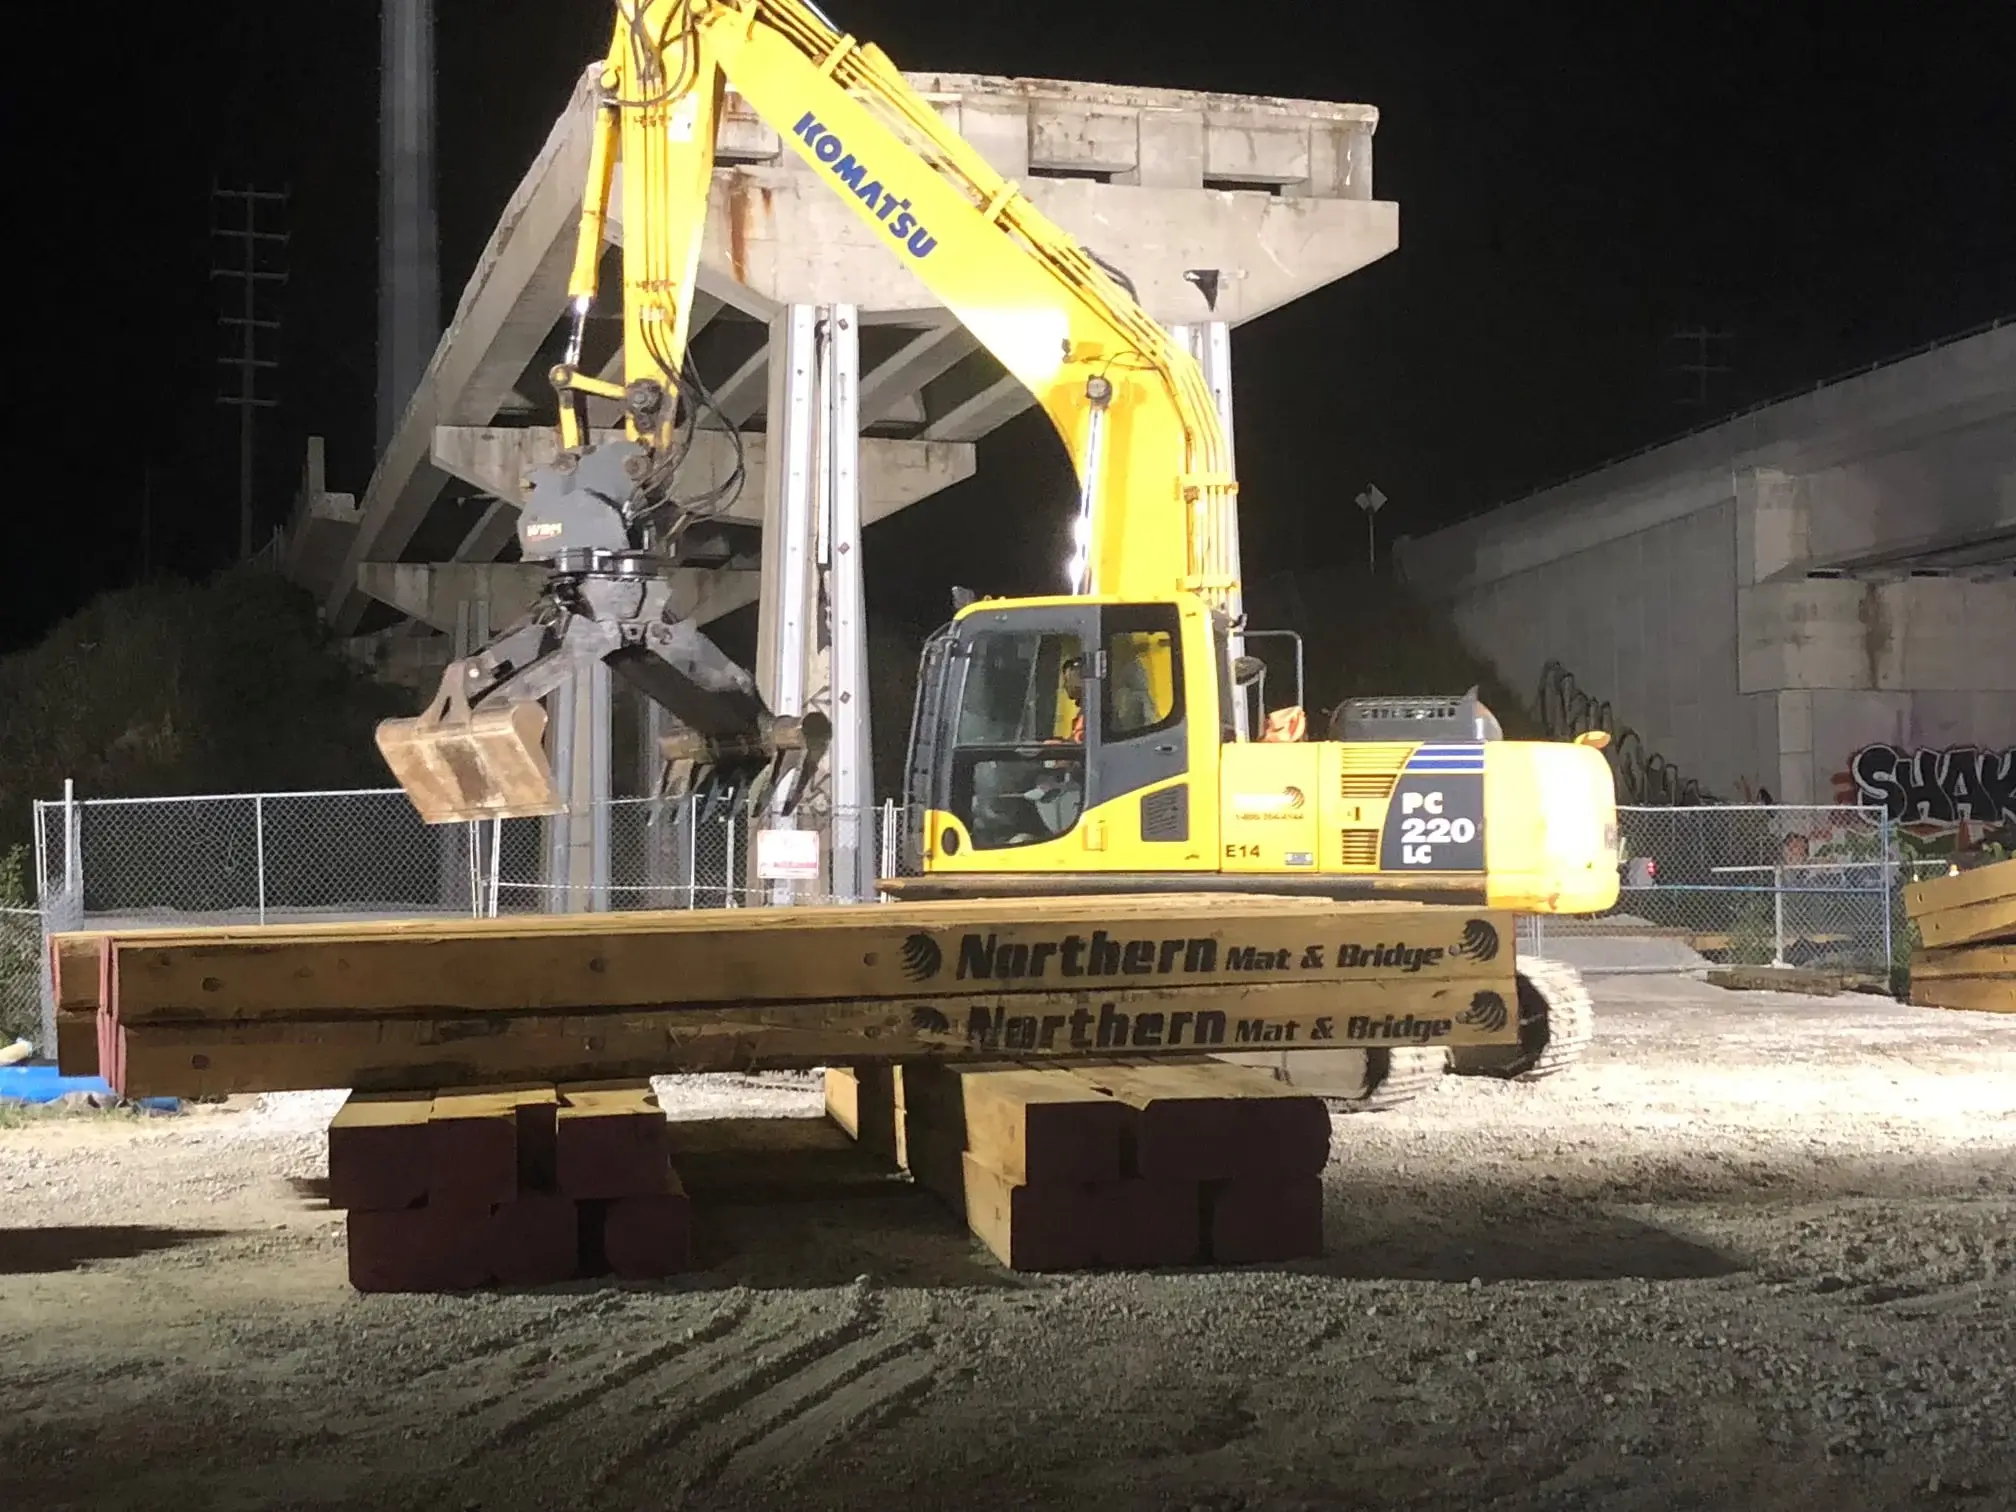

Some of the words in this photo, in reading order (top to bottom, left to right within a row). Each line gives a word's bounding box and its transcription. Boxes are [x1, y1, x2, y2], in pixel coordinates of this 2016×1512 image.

[792, 111, 938, 258] KOMATSU
[1402, 791, 1443, 815] PC
[1401, 817, 1475, 844] 220
[1226, 844, 1260, 858] E14
[1402, 844, 1432, 864] LC
[956, 931, 1218, 981] Northern
[1225, 946, 1291, 971] Mat
[1300, 945, 1324, 970] &
[1336, 942, 1444, 973] Bridge
[967, 1003, 1226, 1051] Northern
[1235, 1018, 1300, 1043] Mat
[1310, 1016, 1333, 1041] &
[1347, 1014, 1452, 1044] Bridge
